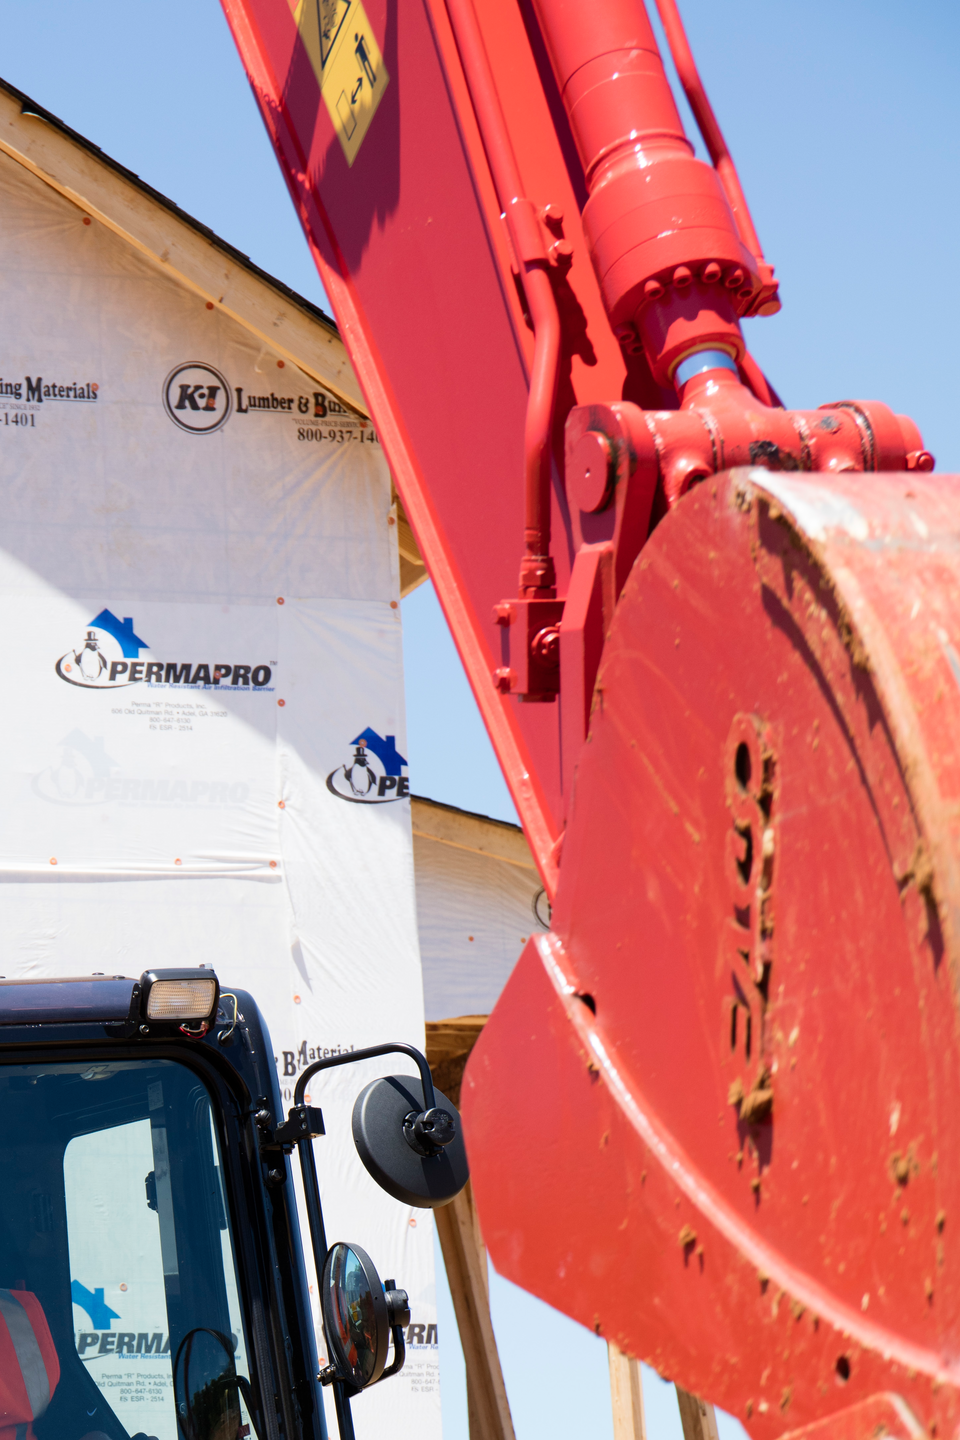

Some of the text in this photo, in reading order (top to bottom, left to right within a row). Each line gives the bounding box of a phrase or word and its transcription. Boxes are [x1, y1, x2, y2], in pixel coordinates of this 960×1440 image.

[25, 376, 98, 403] Materials
[234, 387, 294, 414] Lumber
[297, 395, 309, 414] &
[108, 661, 272, 687] PERMAPRO
